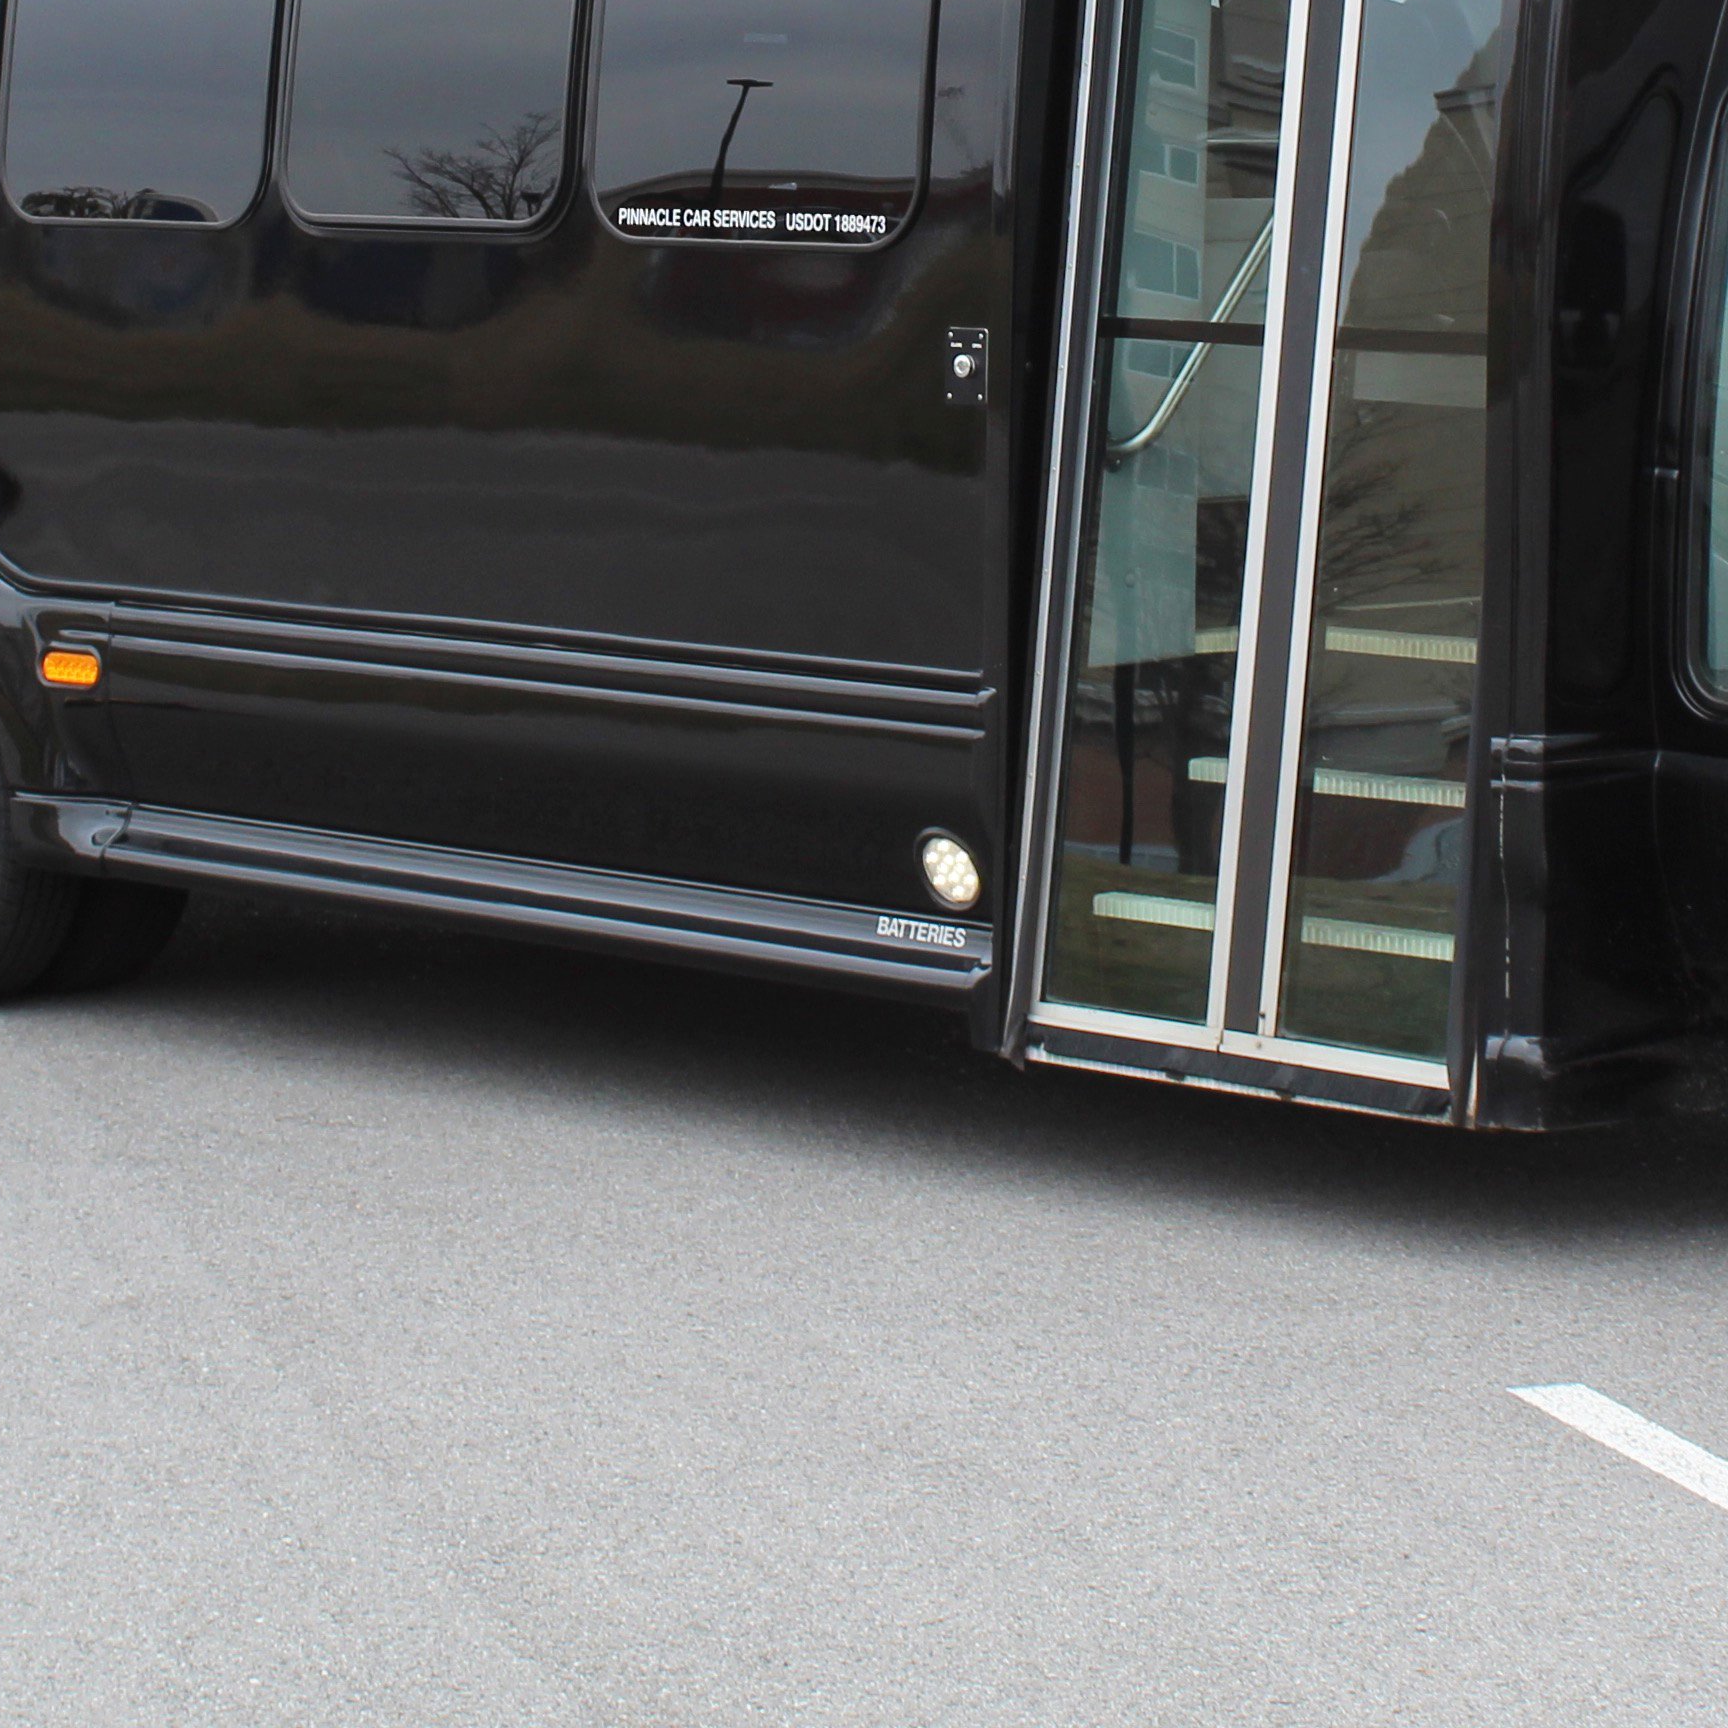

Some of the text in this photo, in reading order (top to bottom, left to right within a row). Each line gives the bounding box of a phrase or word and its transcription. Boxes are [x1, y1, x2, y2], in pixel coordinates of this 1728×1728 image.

[618, 207, 886, 233] PINNACLE CAR SERVICES USDOT 1889473
[876, 915, 967, 948] BATTERIES
